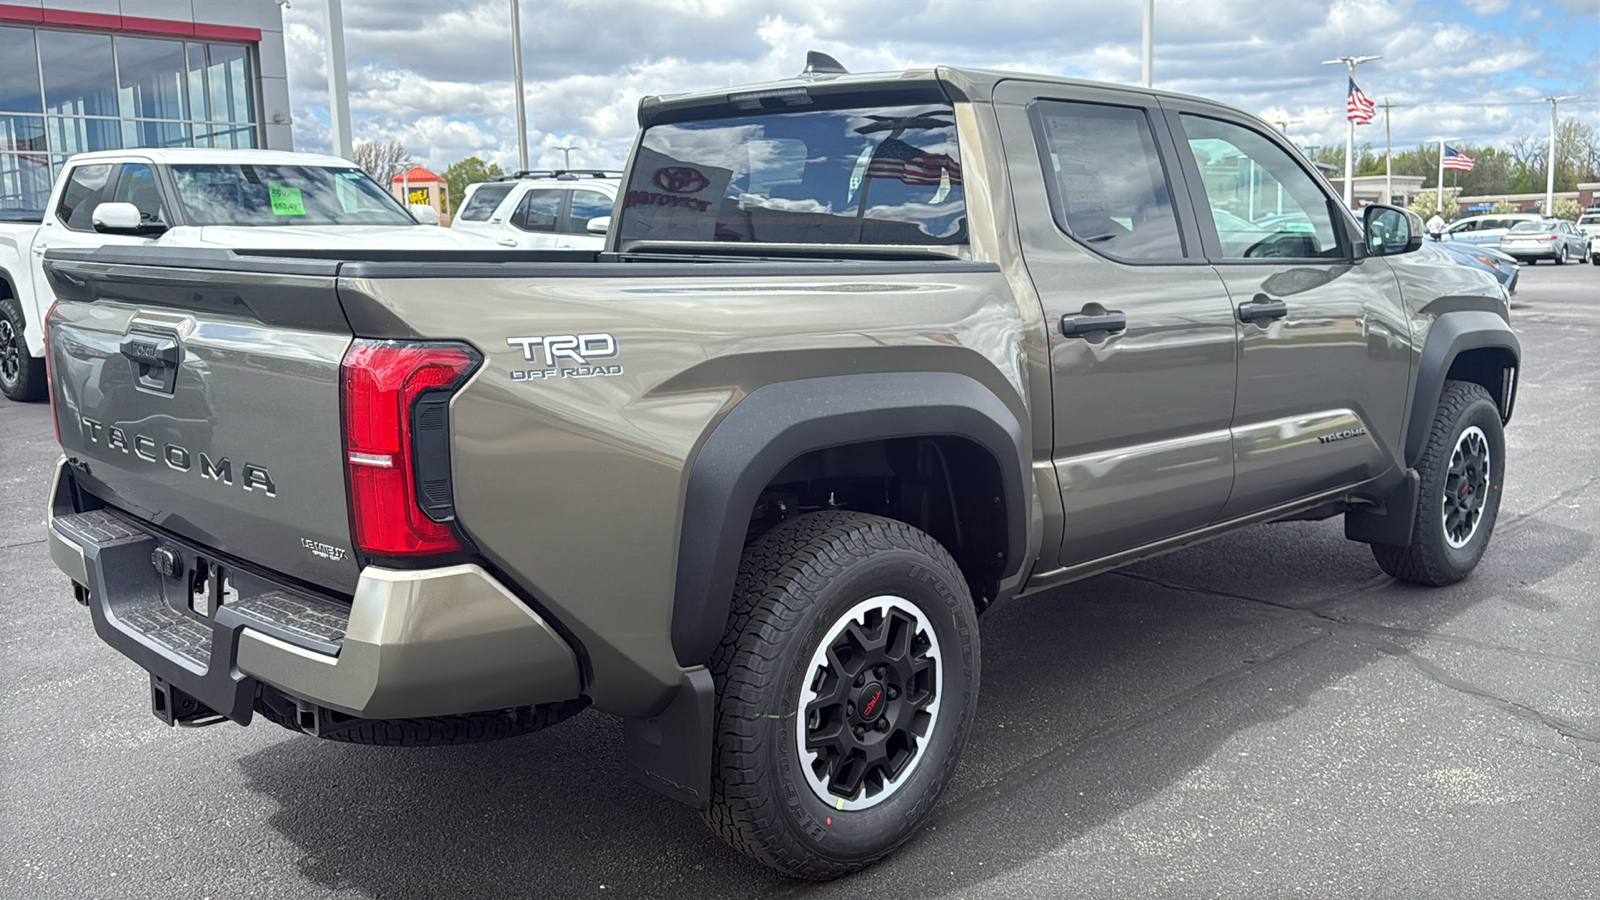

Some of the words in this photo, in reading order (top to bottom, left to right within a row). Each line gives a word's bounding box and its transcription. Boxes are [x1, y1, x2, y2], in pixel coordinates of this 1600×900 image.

[505, 333, 619, 368] TRD
[509, 368, 557, 381] OFF
[561, 365, 623, 380] ROAD
[1318, 427, 1367, 444] TACOMA
[82, 416, 276, 498] TACOMA
[863, 690, 882, 717] TRD
